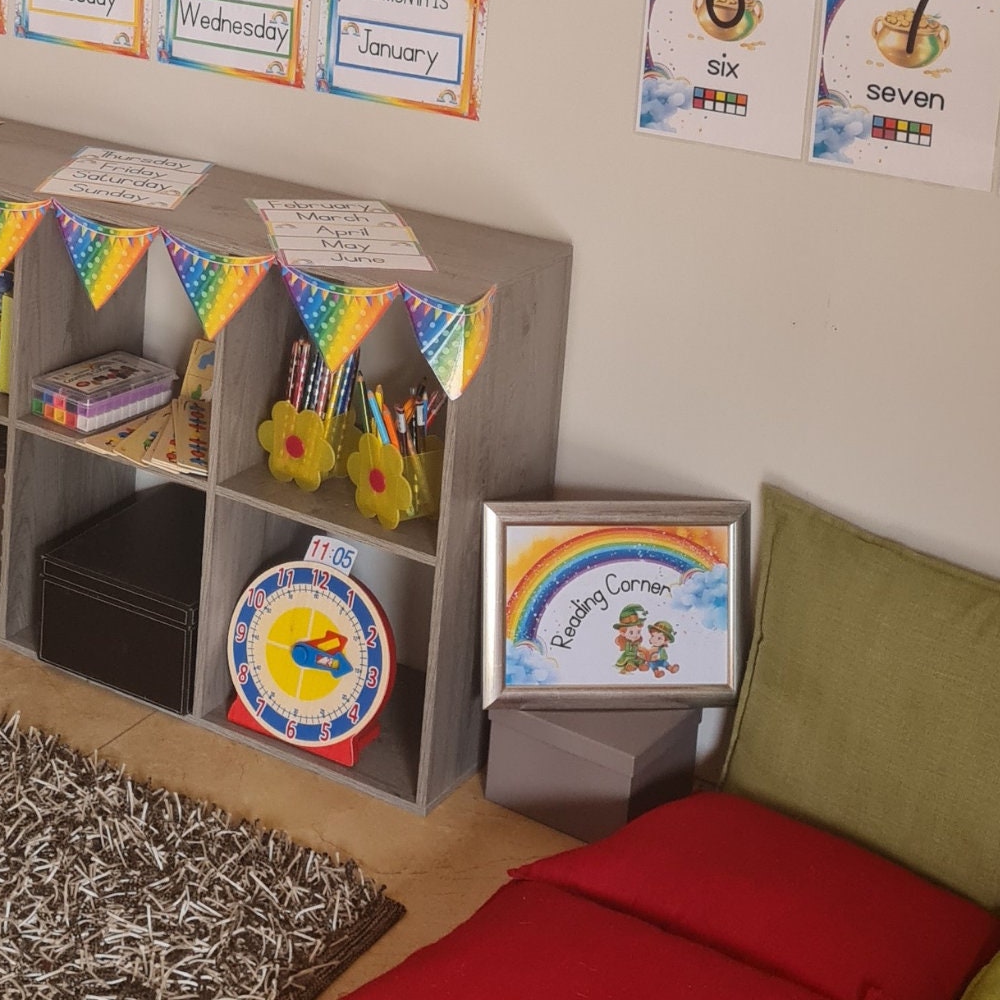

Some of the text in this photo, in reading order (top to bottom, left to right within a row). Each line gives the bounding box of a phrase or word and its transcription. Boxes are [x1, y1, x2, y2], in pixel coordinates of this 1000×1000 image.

[180, 0, 289, 52] Wednesday
[358, 29, 439, 75] January
[707, 53, 739, 79] six
[866, 83, 945, 111] seven
[101, 151, 191, 169] Thursday
[100, 163, 168, 179] Friday
[72, 171, 172, 192] Saturday
[70, 183, 150, 202] Sunday
[268, 200, 369, 212] February
[296, 212, 369, 222] March
[316, 225, 369, 238] April
[321, 240, 370, 252] May
[331, 253, 385, 263] June
[311, 539, 352, 568] 11:05
[278, 568, 293, 587] 11
[312, 569, 329, 590] 12
[248, 588, 264, 608] 10
[550, 573, 671, 649] Reading Corner
[236, 624, 246, 642] 9
[367, 627, 376, 647] 2
[238, 664, 249, 684] 8
[367, 668, 377, 687] 3
[256, 699, 266, 717] 7
[348, 703, 359, 722] 4
[286, 721, 296, 739] 6
[320, 723, 330, 741] 5
